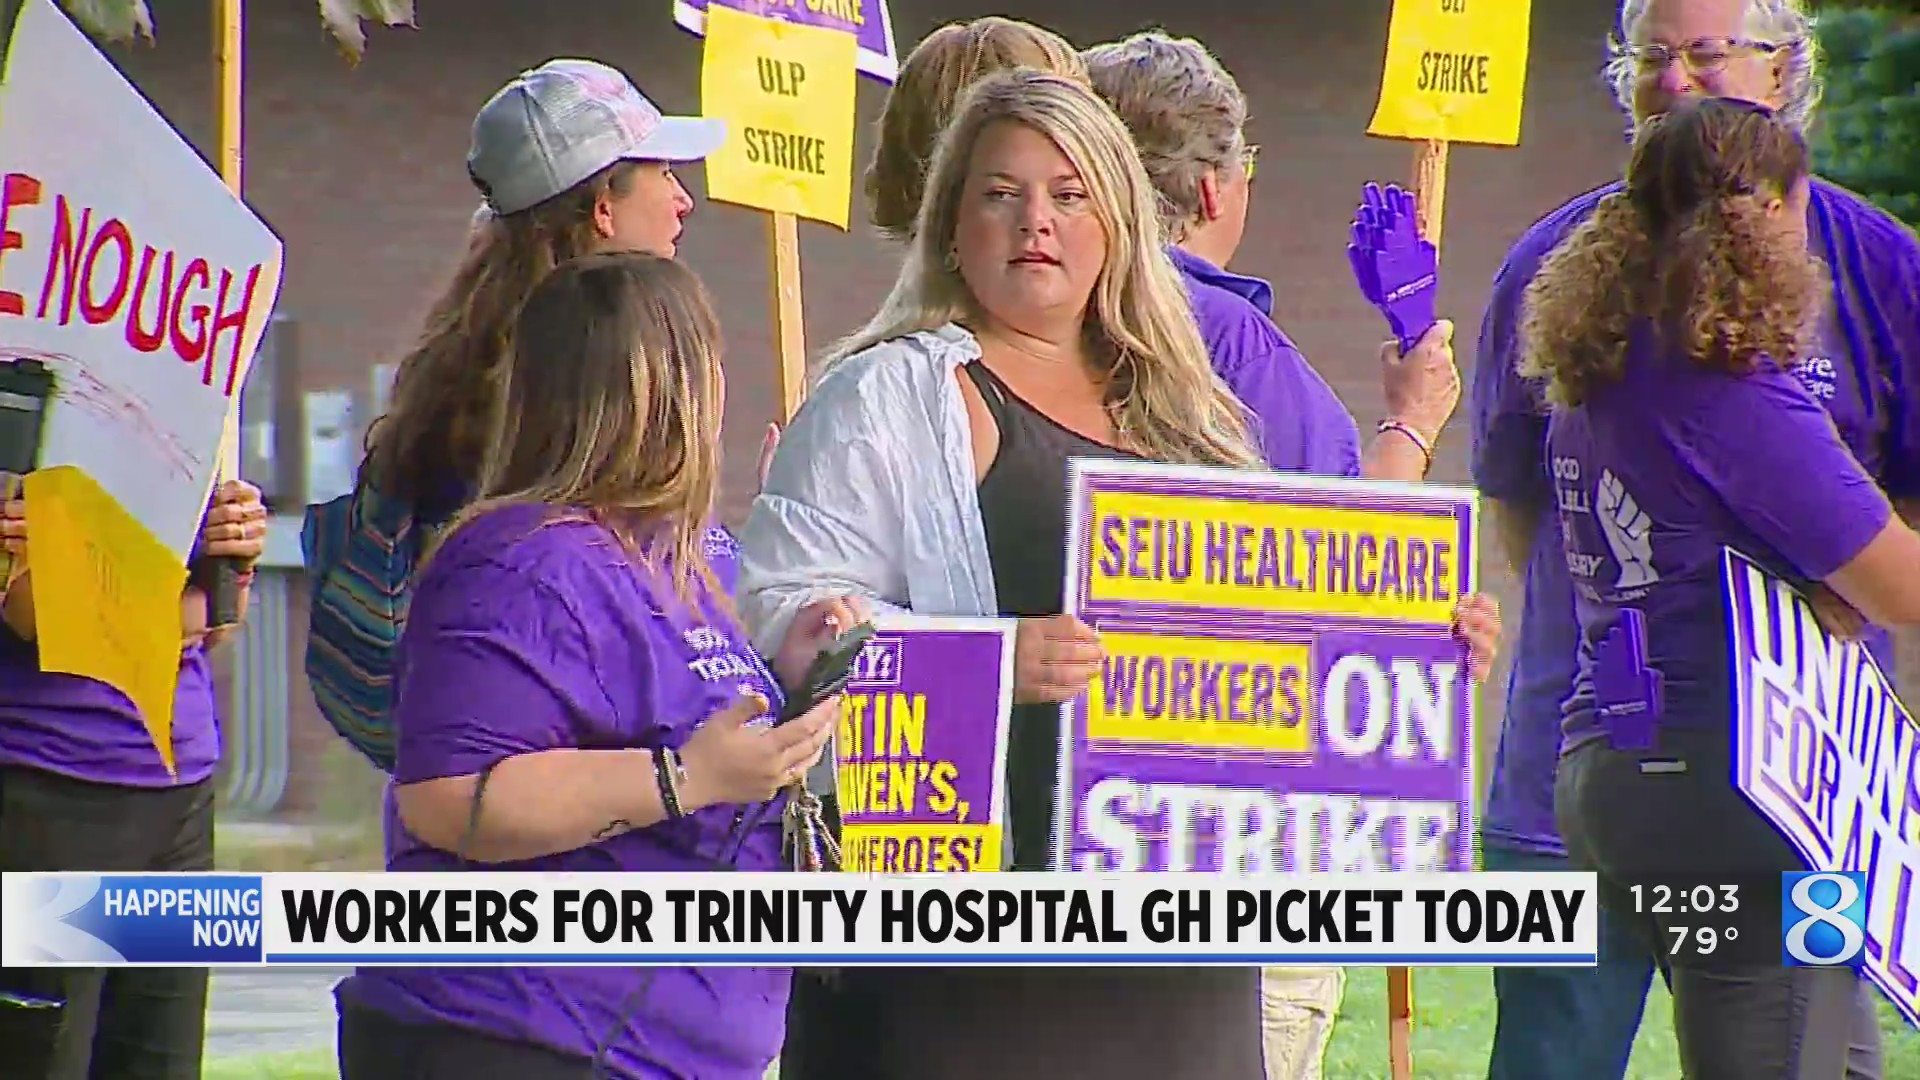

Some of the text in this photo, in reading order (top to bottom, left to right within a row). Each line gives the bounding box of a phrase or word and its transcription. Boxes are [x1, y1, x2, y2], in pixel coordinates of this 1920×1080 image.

[756, 55, 805, 97] ULP
[1418, 50, 1490, 94] STRIKE
[743, 126, 825, 176] STRIKE
[1098, 514, 1451, 602] SEIU HEALTHCARE
[873, 692, 927, 758] IN
[1102, 653, 1458, 761] WORKERS ON
[1762, 677, 1841, 842] FOR
[1080, 775, 1459, 872] STRIKE
